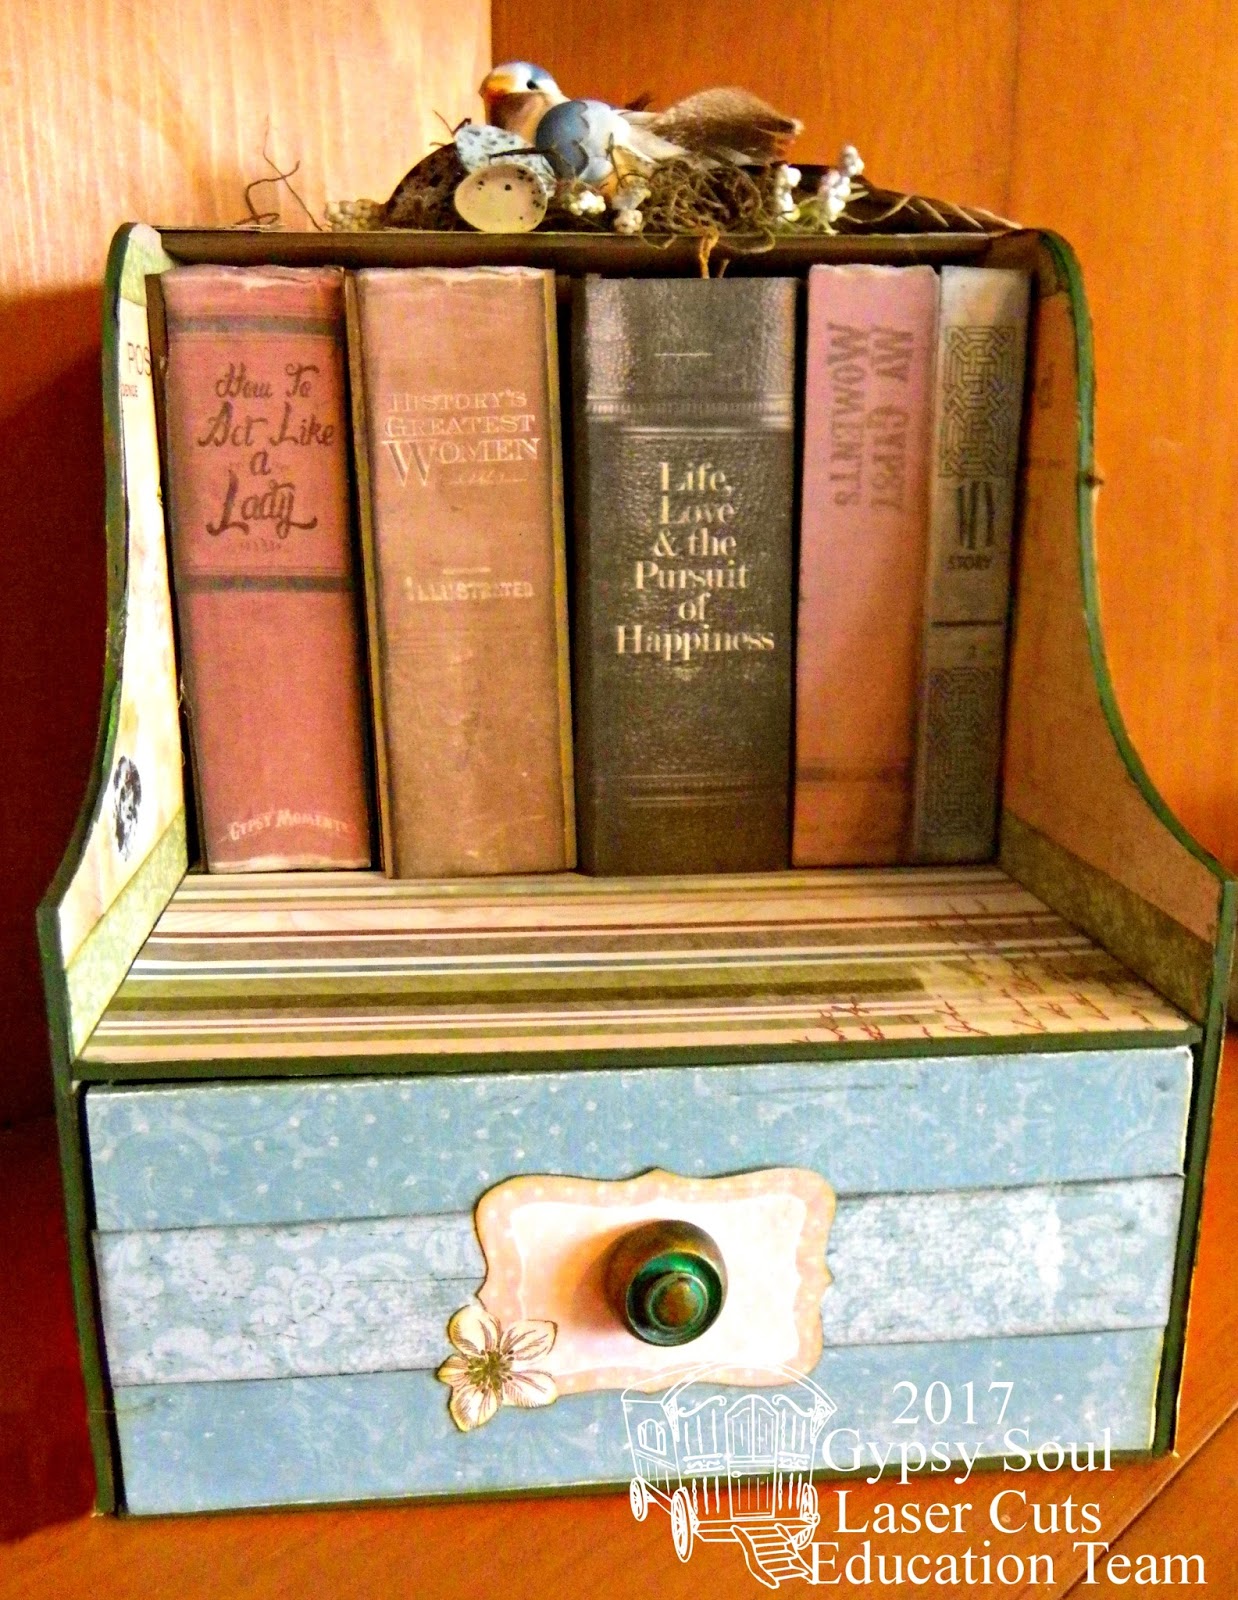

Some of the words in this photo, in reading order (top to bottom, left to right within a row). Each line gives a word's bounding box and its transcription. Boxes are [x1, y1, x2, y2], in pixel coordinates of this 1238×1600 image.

[215, 363, 273, 398] How
[285, 363, 319, 397] To
[389, 389, 527, 412] HISTORY'S
[197, 402, 266, 447] Act
[269, 403, 336, 446] Like
[385, 415, 535, 438] GREATEST
[250, 450, 271, 475] a
[381, 438, 541, 487] WOMEN
[659, 462, 733, 496] Life,
[206, 470, 318, 539] Lady
[659, 495, 735, 524] Love
[652, 526, 678, 556] &
[687, 528, 737, 556] the
[634, 560, 749, 589] Pursuit
[678, 592, 711, 621] of
[616, 624, 775, 661] Happiness
